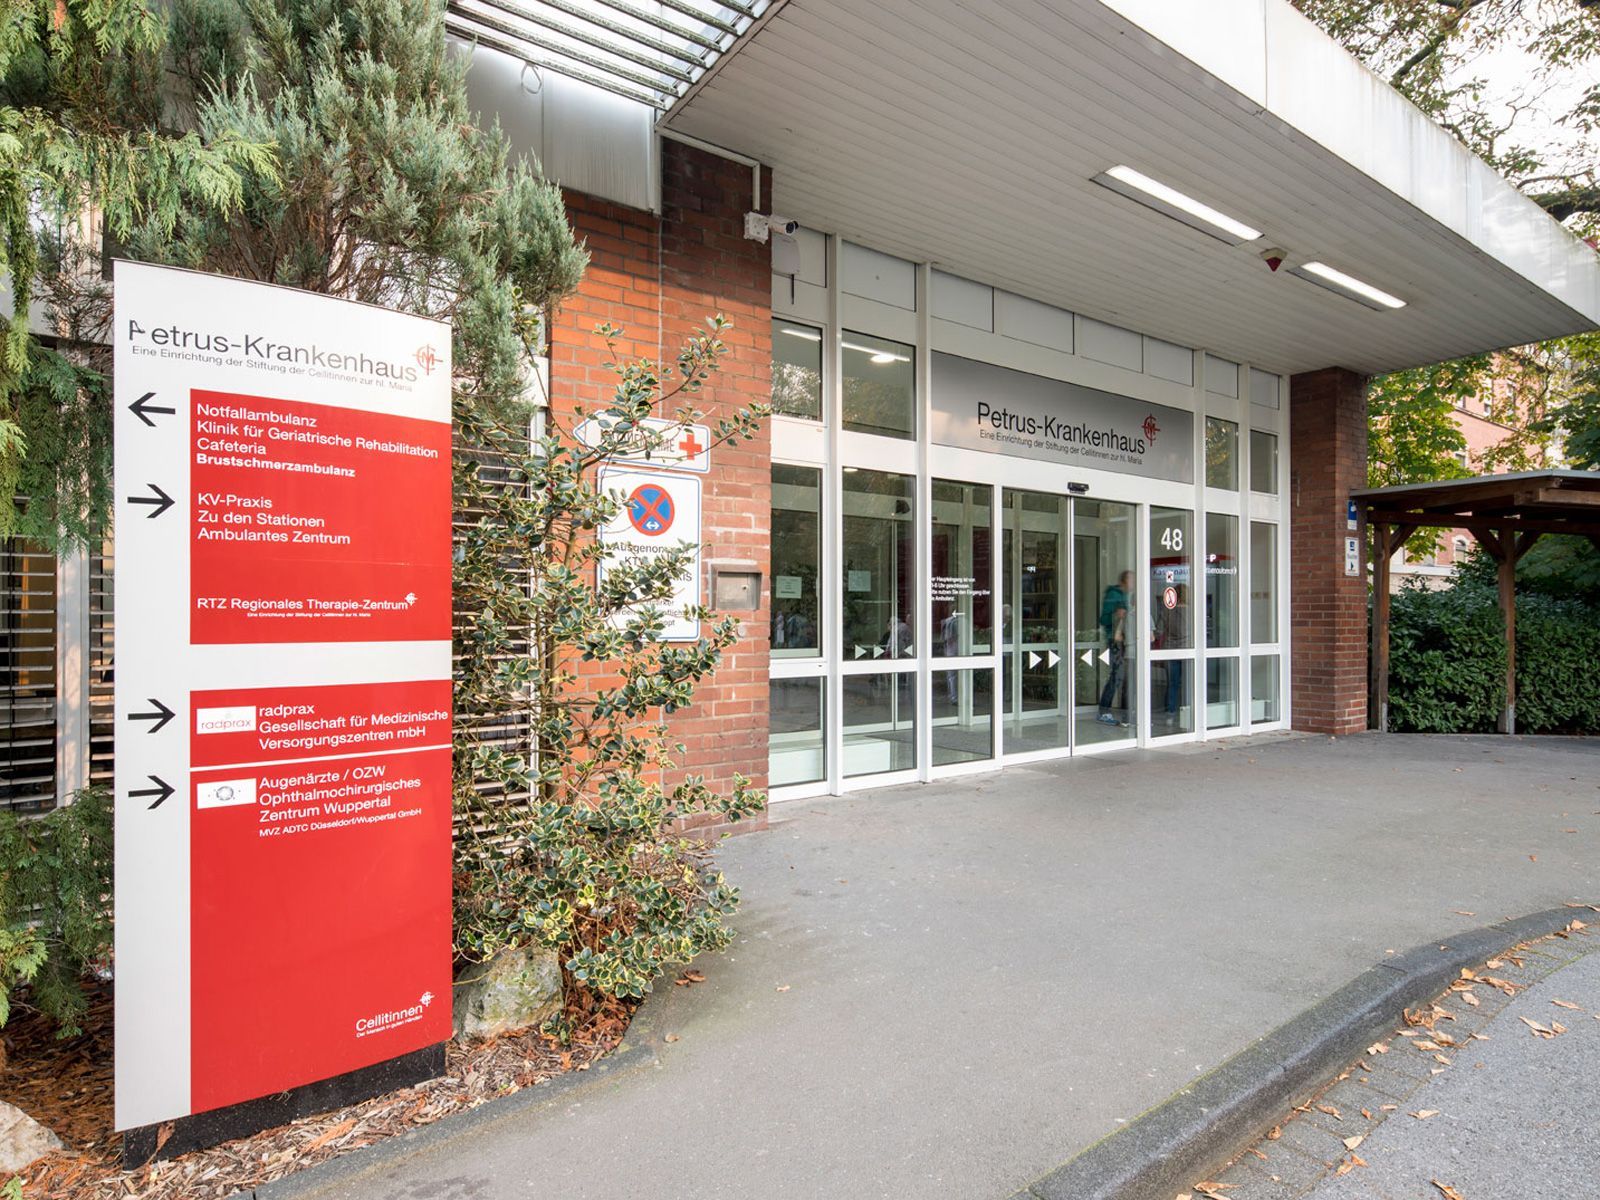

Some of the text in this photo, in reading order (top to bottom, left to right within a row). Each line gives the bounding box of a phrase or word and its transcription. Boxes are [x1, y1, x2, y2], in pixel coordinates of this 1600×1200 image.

[132, 345, 157, 357] Eine
[160, 348, 223, 366] Einrichtung
[225, 357, 243, 367] der
[246, 359, 286, 374] Stiftung
[289, 365, 305, 375] der
[359, 377, 373, 386] zur
[196, 403, 317, 428] Notfallambulanz
[977, 401, 1146, 454] Petrus-Krankenhaus
[196, 421, 438, 459] Klinik für Geriatrische Rehabilitation
[197, 438, 267, 455] Cafeteria
[980, 429, 995, 441] Eine
[996, 432, 1032, 448] Einrichtung
[1034, 440, 1045, 449] der
[1045, 440, 1069, 455] Stiftung
[1070, 445, 1080, 454] der
[1110, 453, 1120, 461] zur
[1127, 455, 1143, 465] Maria
[196, 453, 356, 478] Brustschmerzambulanz
[198, 493, 273, 509] KV-Praxis
[198, 510, 325, 528] Zu den Stationen
[197, 527, 351, 545] Ambulantes Zentrum
[1161, 527, 1183, 551] 48
[197, 598, 409, 611] RTZ Regionales Therapie-Zentrum
[259, 704, 315, 719] radprax
[259, 710, 449, 734] Gesellschaft für Medizinische
[201, 719, 252, 731] radprax
[259, 725, 426, 751] Versorgungszentren mbH
[259, 765, 386, 790] Augenärzte / OZW
[259, 777, 421, 809] Ophthalmochirurgisches
[259, 796, 391, 823] Zentrum Wuppertal
[259, 808, 422, 838] MVZ ADTC Düsseldorf/Wuppertal GmbH
[355, 1004, 423, 1032] Cellitinnen
